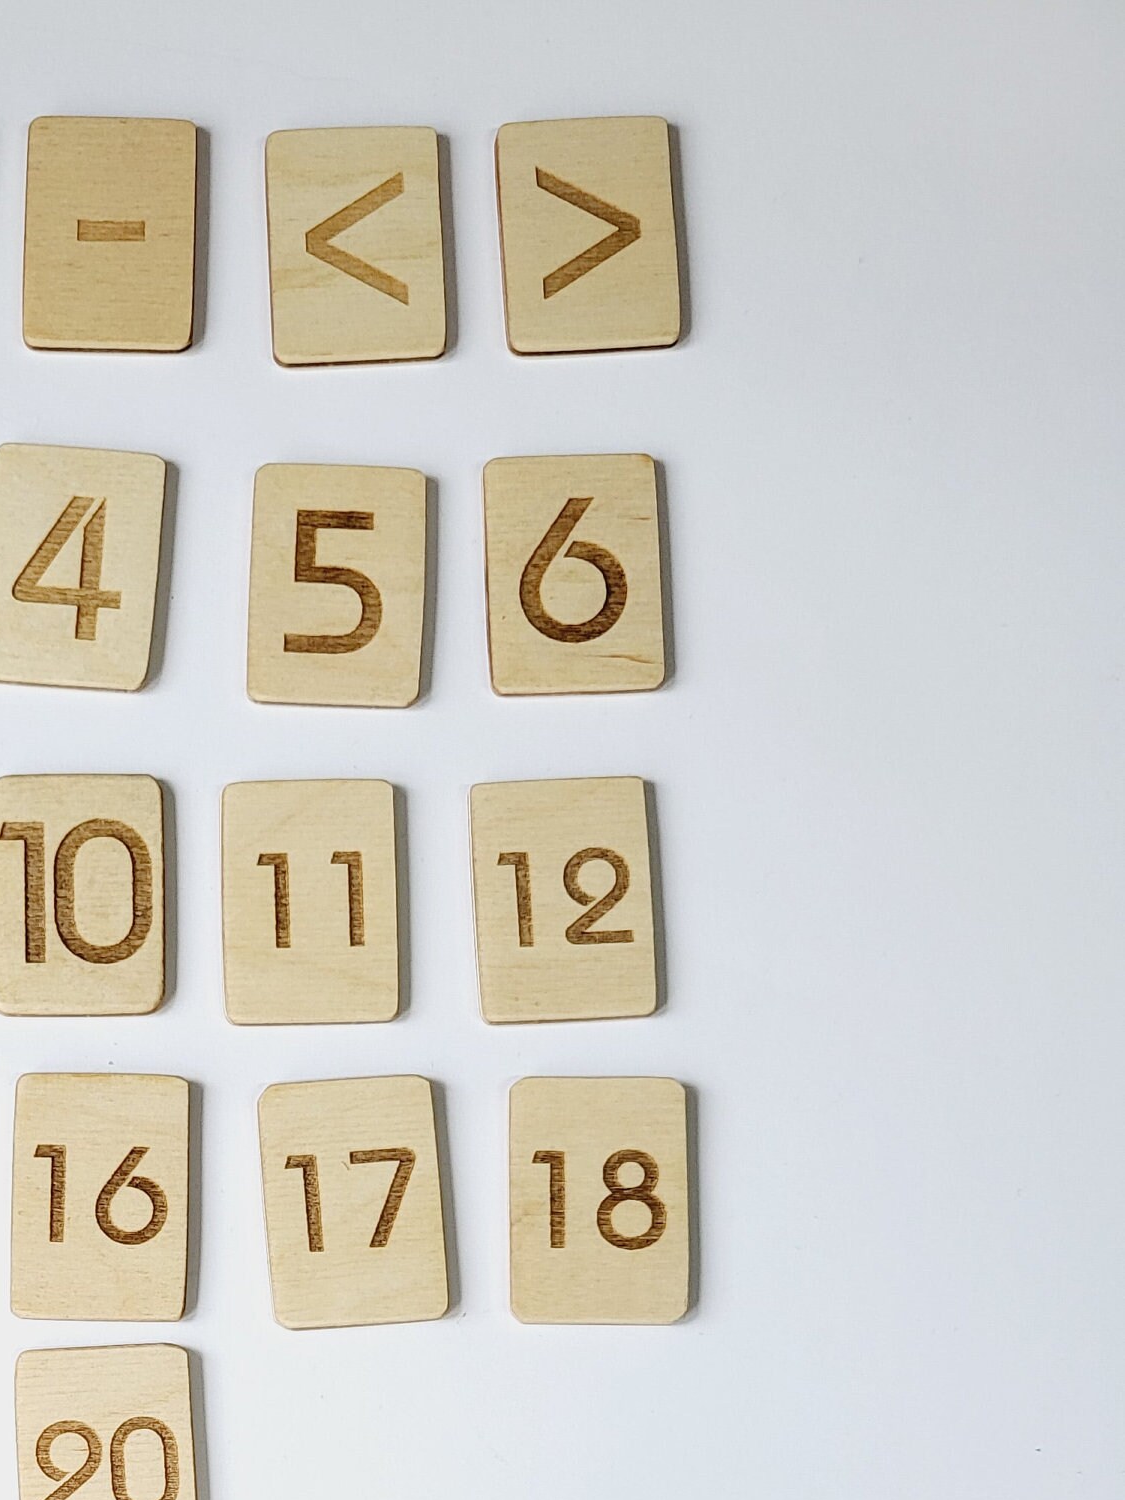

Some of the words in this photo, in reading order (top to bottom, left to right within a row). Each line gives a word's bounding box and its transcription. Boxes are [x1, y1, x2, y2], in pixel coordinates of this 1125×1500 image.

[11, 496, 120, 641] 4
[283, 510, 382, 654] 5
[519, 497, 627, 643] 6
[257, 851, 364, 948] 11
[497, 847, 634, 947] 12
[34, 1145, 167, 1245] 16
[285, 1148, 416, 1252] 17
[532, 1150, 666, 1250] 18
